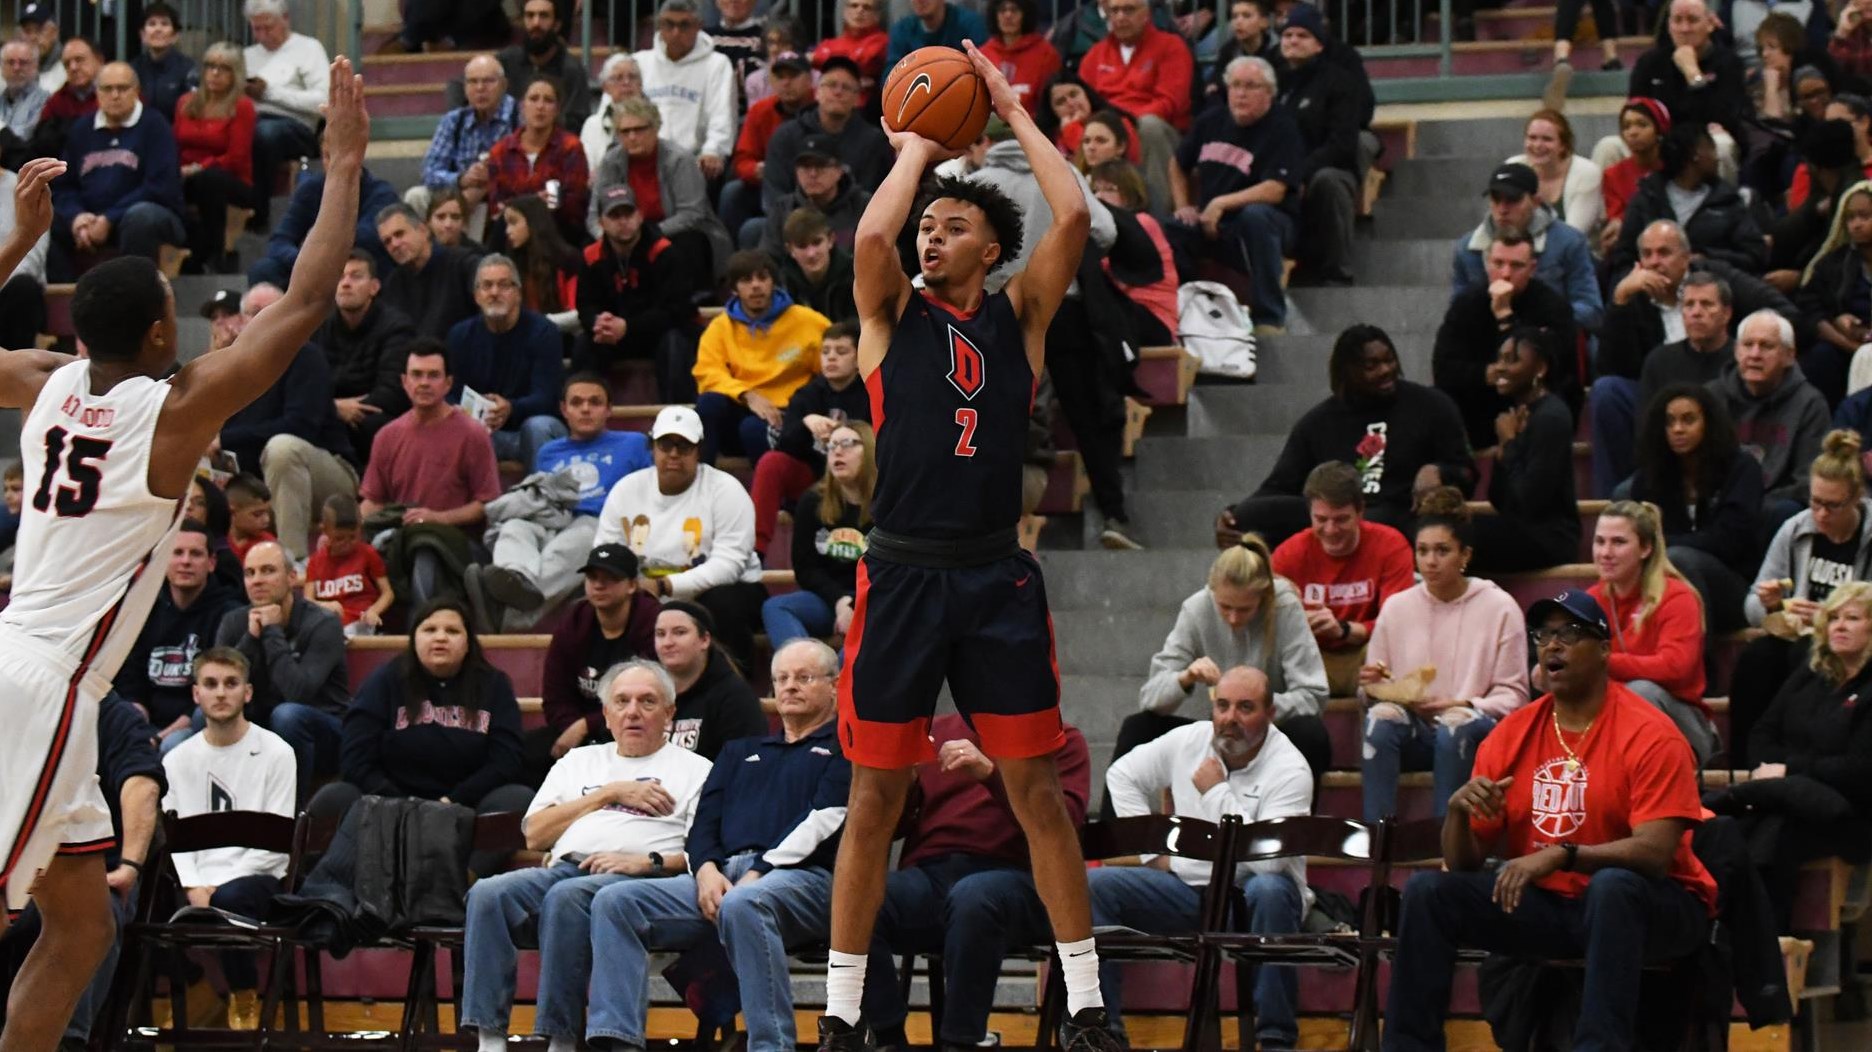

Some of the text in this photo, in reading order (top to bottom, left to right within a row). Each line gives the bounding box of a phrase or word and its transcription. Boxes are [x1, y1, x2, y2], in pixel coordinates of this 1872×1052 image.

[945, 322, 985, 401] D
[61, 394, 115, 428] ATOOD
[955, 407, 978, 457] 2
[32, 425, 115, 518] 15
[315, 574, 364, 598] LOPES
[395, 699, 491, 734] DQUESE
